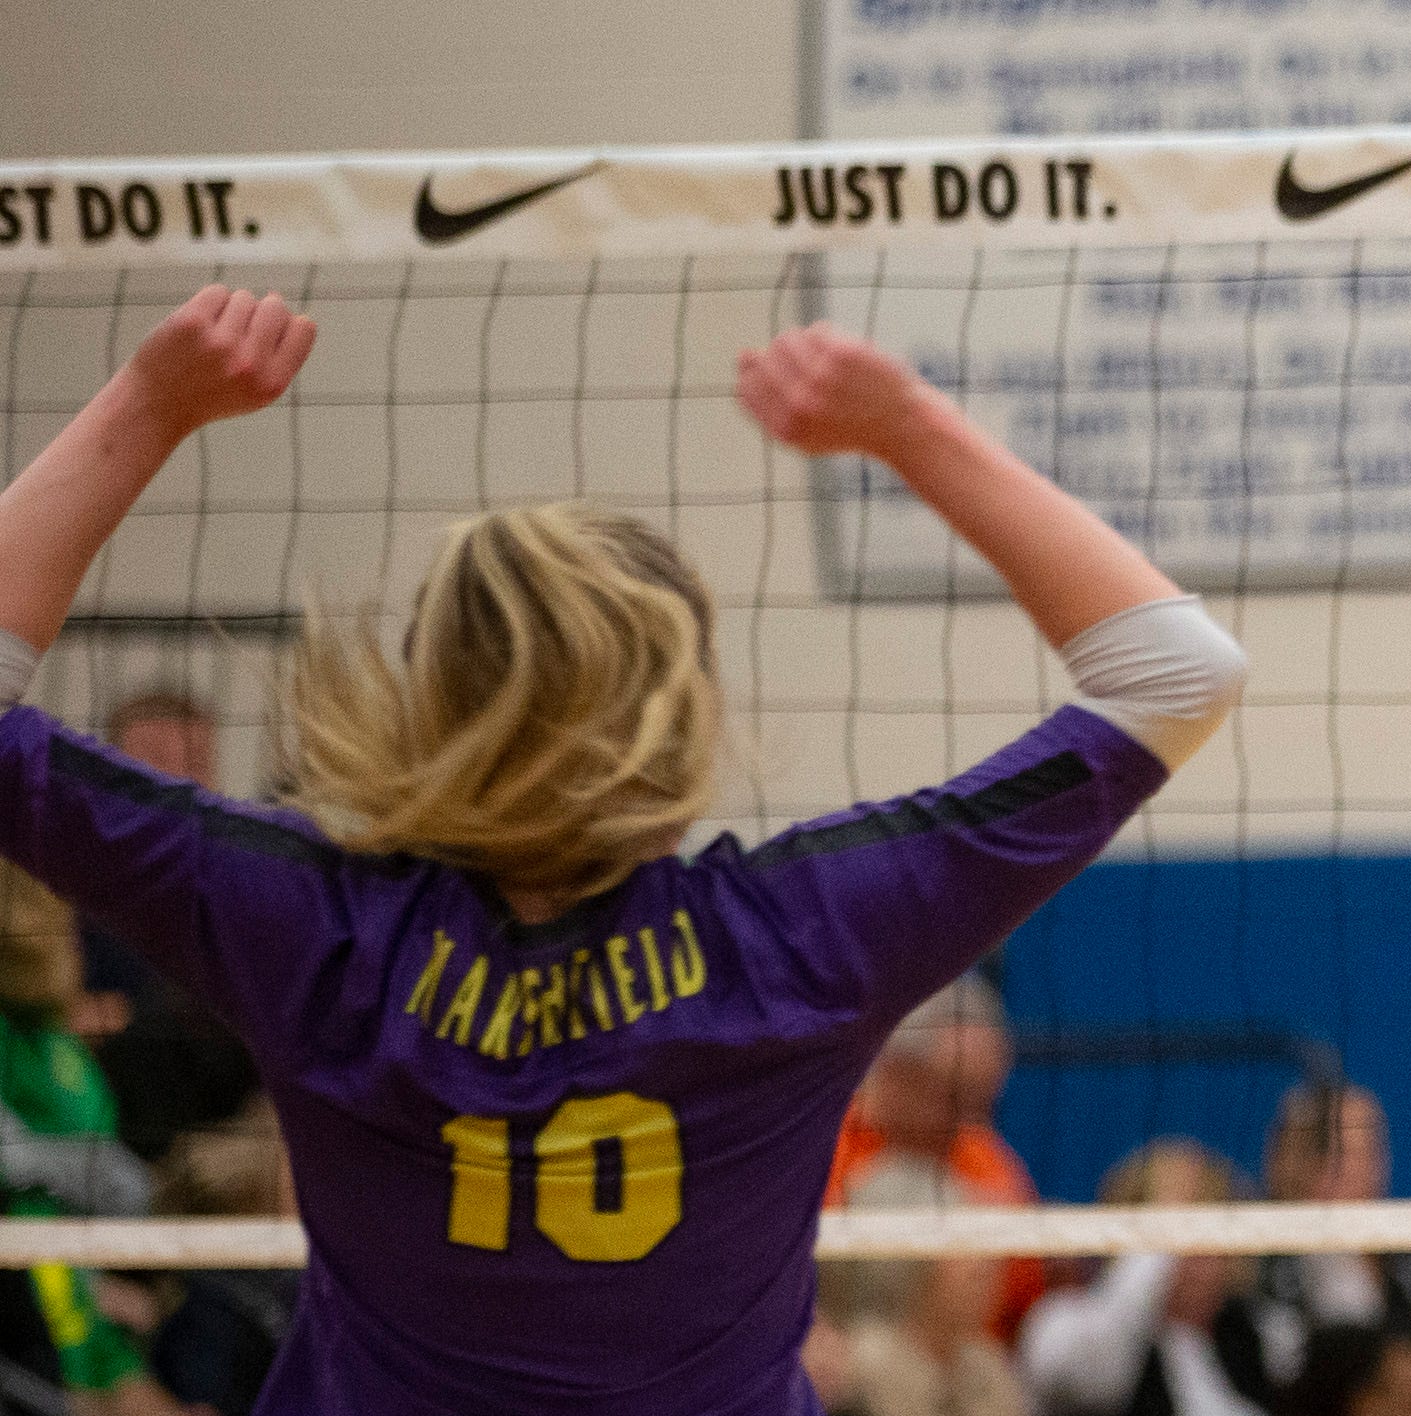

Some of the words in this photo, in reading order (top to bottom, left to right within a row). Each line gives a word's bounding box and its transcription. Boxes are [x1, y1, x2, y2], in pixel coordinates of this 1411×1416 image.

[75, 180, 163, 240] DO
[183, 179, 260, 238] IT.
[774, 164, 905, 226] JUST
[932, 160, 1019, 222] DO
[1044, 160, 1118, 219] IT.
[440, 1091, 683, 1261] 10
